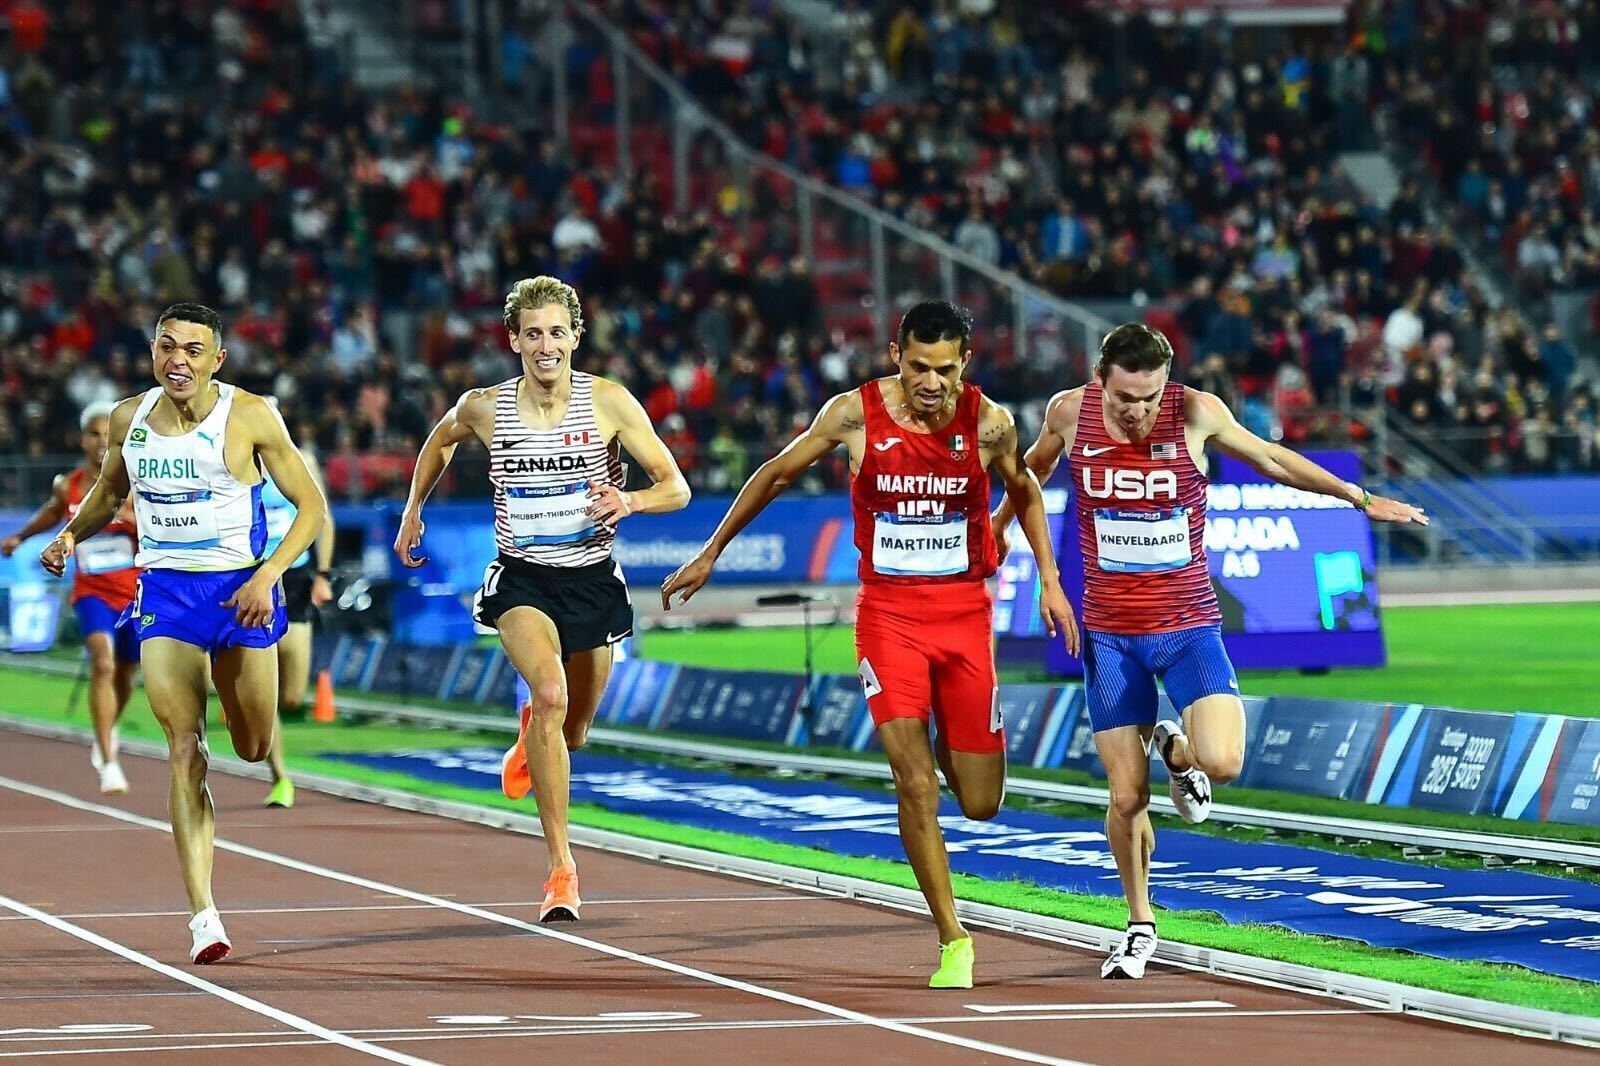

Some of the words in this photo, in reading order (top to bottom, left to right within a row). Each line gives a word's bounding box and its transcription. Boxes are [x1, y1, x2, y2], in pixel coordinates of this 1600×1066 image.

[138, 458, 200, 479] BRASIL
[503, 455, 588, 473] CANADA
[876, 472, 969, 495] MARTÍNEZ
[1082, 467, 1178, 500] USA
[151, 515, 164, 526] DA
[164, 516, 199, 528] SILVA
[880, 535, 962, 551] MARTINEZ
[1100, 533, 1185, 547] KNEVELBAARD
